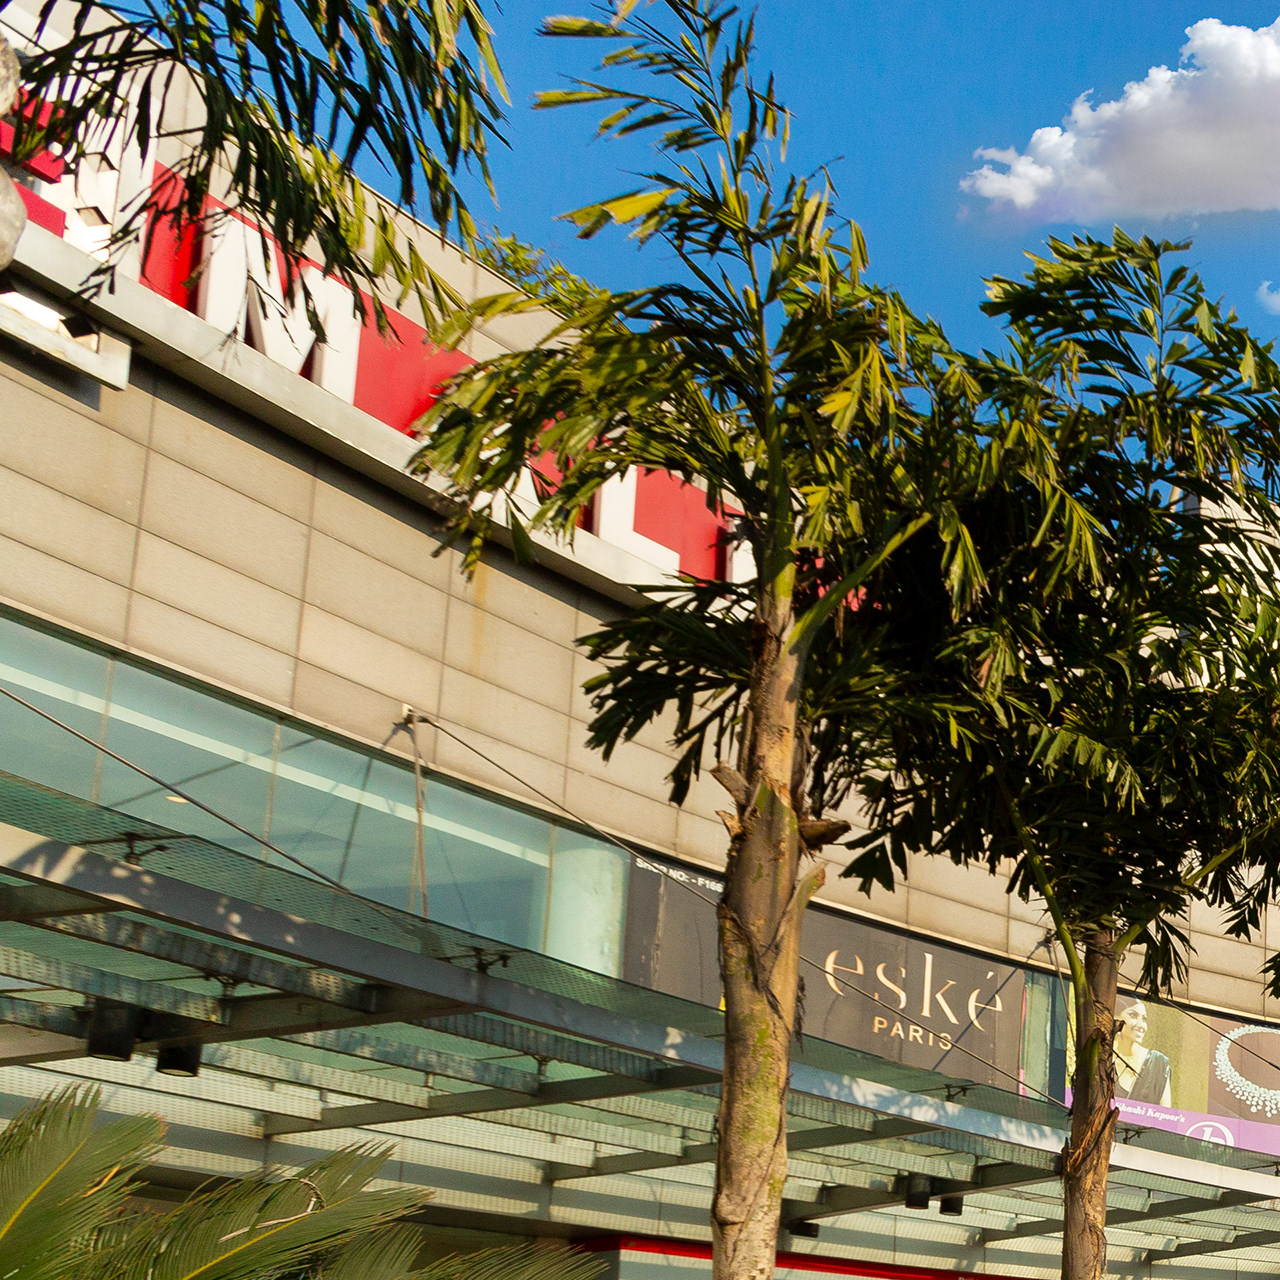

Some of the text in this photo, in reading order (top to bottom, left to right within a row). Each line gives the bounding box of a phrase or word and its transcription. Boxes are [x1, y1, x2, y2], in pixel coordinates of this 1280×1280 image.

[825, 950, 1003, 1032] eské
[872, 1016, 953, 1050] PARIS
[1147, 1107, 1186, 1123] Kapoor's
